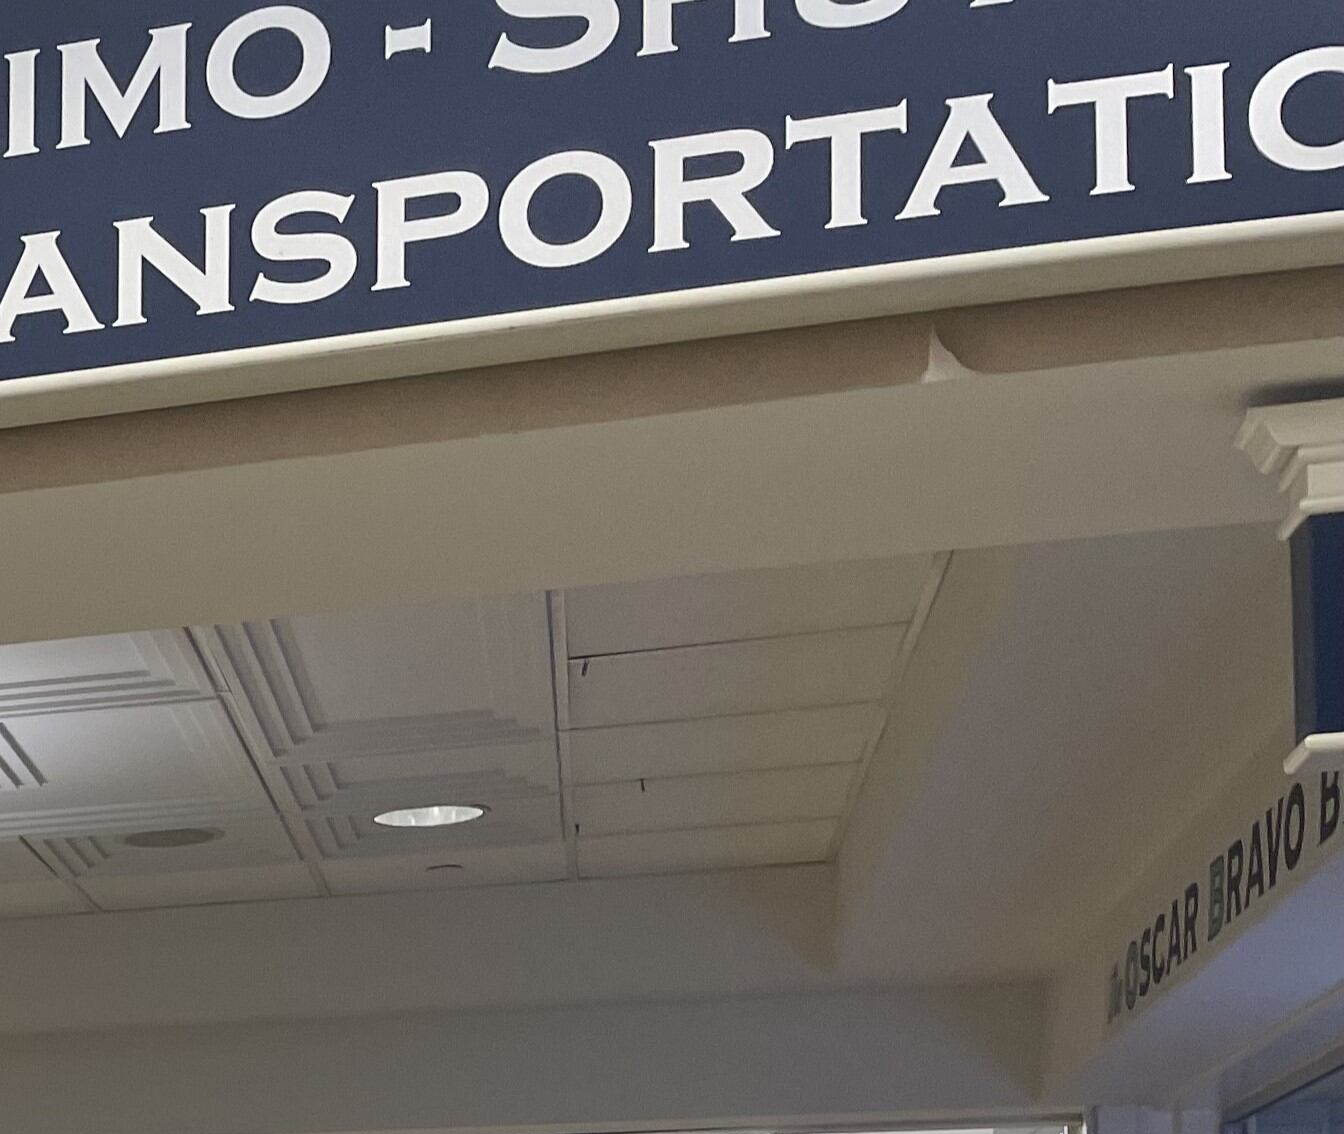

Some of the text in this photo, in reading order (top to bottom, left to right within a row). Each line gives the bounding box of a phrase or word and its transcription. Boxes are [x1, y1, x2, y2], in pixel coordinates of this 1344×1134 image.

[1125, 882, 1199, 1011] OSCAR
[1208, 782, 1306, 942] BRAVO
[1316, 770, 1344, 847] B
